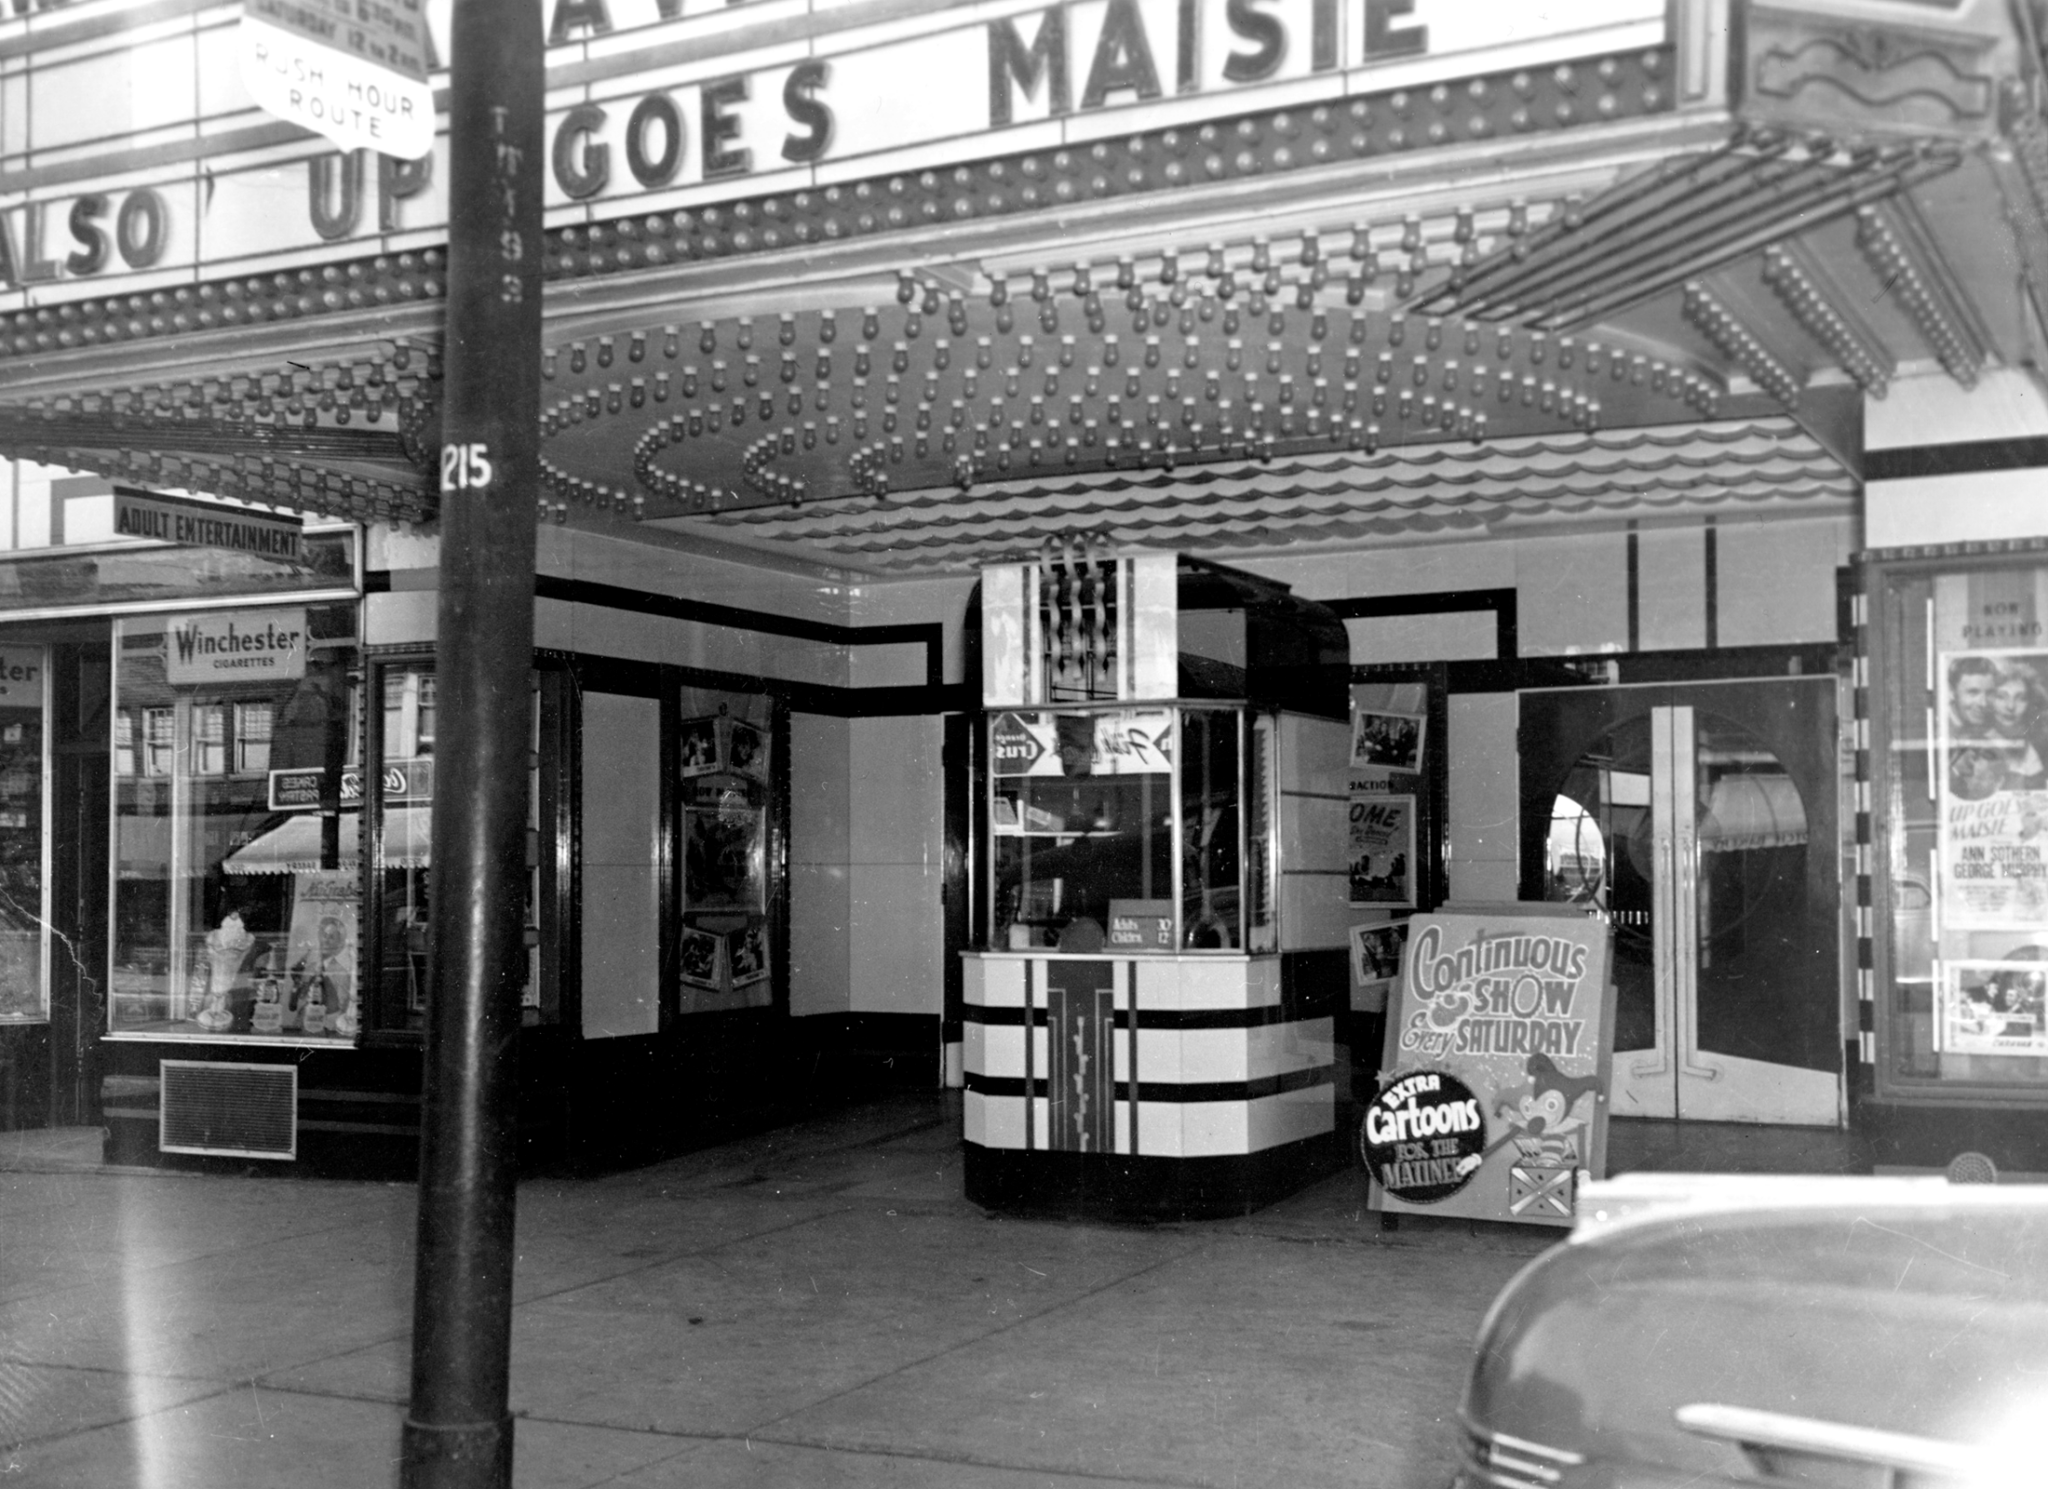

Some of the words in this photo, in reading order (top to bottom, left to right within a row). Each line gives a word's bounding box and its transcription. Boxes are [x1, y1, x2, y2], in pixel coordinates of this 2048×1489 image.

[256, 43, 324, 86] RUSH
[348, 80, 414, 119] HOUR
[290, 88, 382, 139] ROUTE
[308, 150, 434, 240] UP
[551, 57, 837, 200] GOES
[986, 0, 1430, 129] MAISIE
[440, 443, 493, 492] 215
[118, 506, 170, 538] ADULT
[1983, 602, 2019, 616] NOW
[175, 622, 300, 666] Winchester
[1963, 621, 2043, 638] PLAYING
[213, 656, 276, 669] CIGARETTES
[1954, 863, 1995, 879] GEORGE
[2001, 862, 2048, 879] MURPHY
[1962, 846, 1985, 861] ANN
[1990, 846, 2041, 861] SOTHERN
[1473, 973, 1581, 1018] SHOW
[1454, 1018, 1586, 1058] SATURDAY
[1381, 1074, 1441, 1110] EXTRA
[1366, 1096, 1481, 1145] Cartoons
[1394, 1140, 1430, 1162] FOR
[1430, 1137, 1460, 1158] THE
